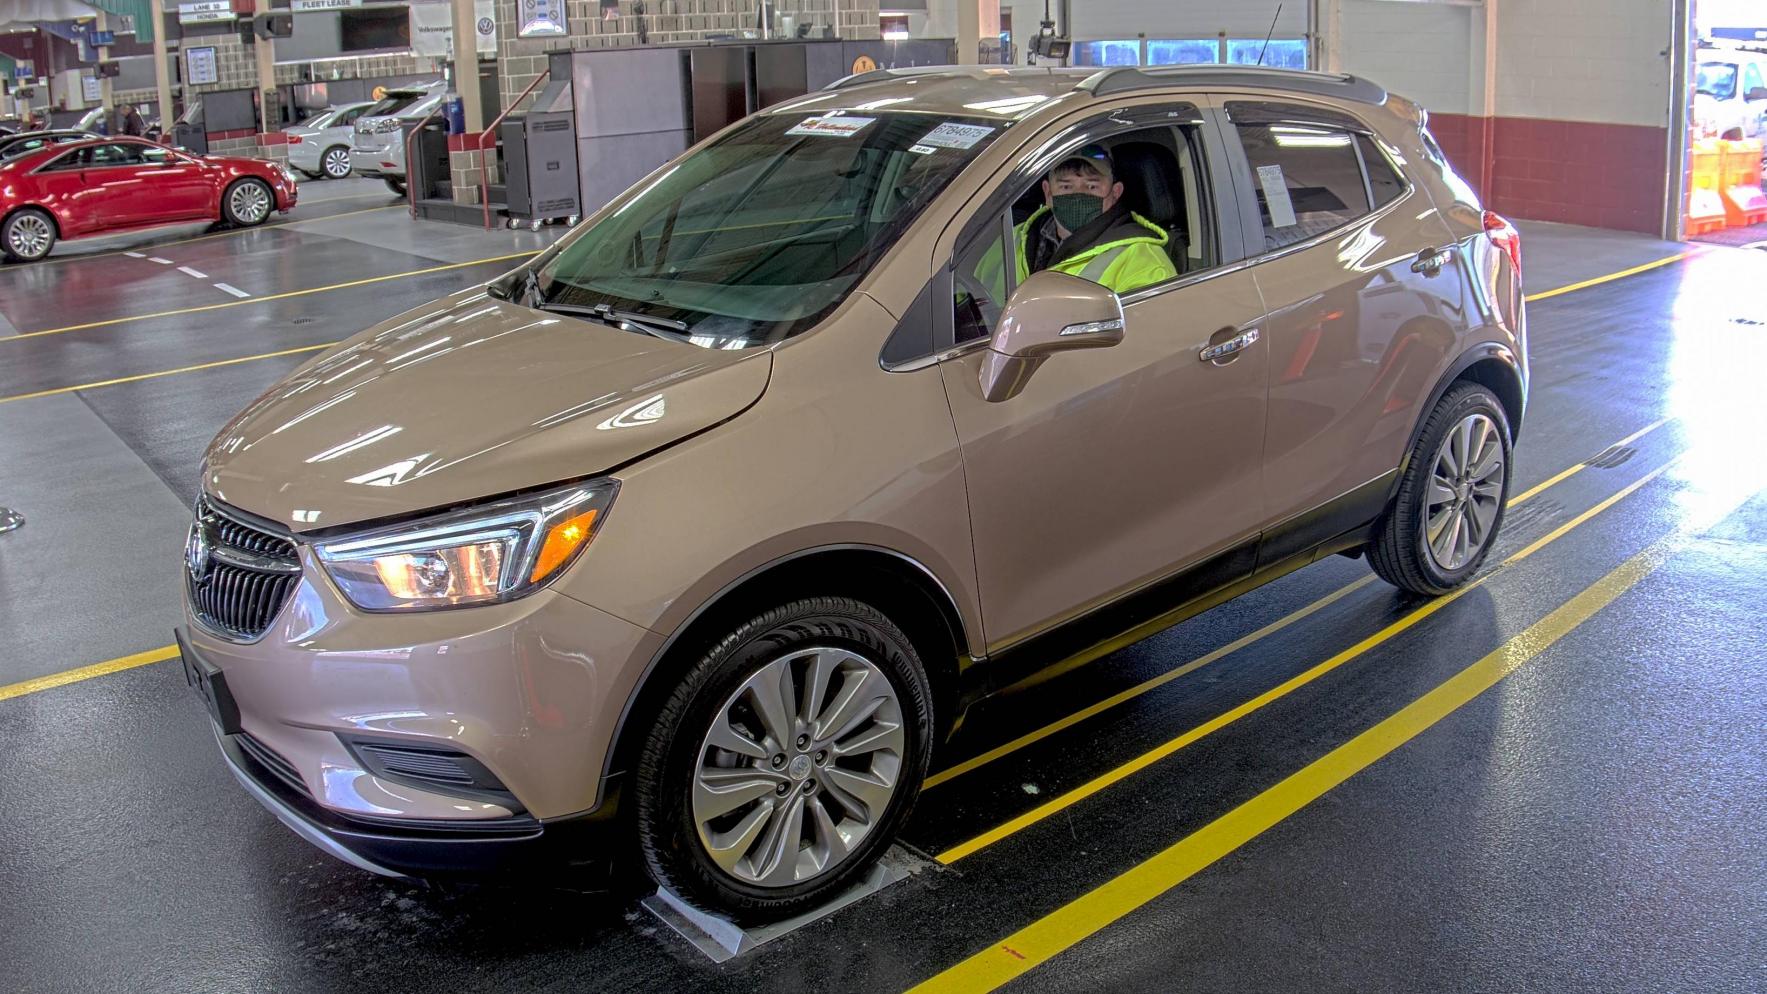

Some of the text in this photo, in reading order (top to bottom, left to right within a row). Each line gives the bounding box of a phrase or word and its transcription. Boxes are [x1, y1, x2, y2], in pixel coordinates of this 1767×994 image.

[193, 3, 211, 11] LANE
[935, 125, 985, 138] 6784975
[893, 651, 926, 718] Continental
